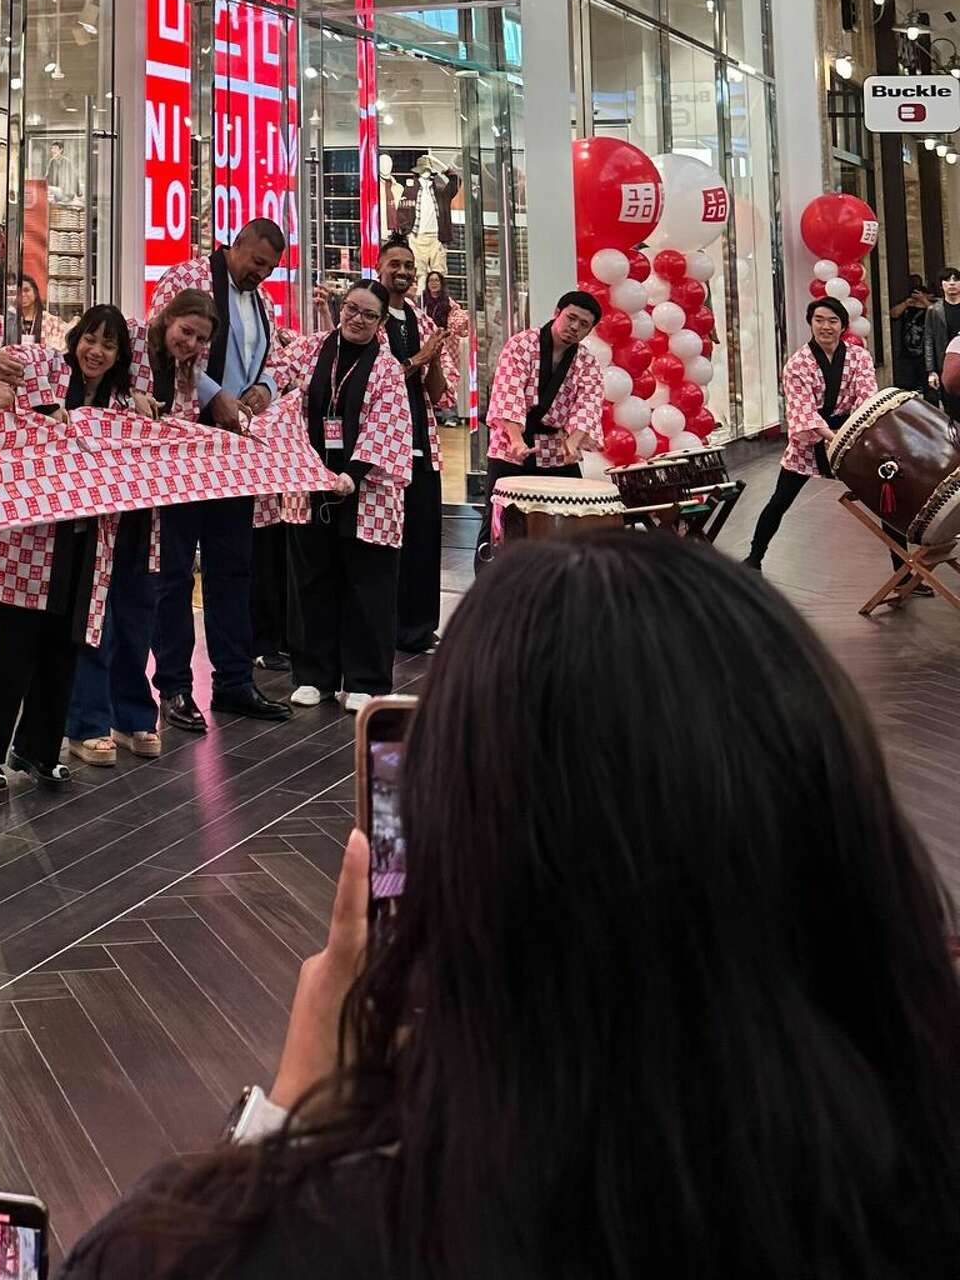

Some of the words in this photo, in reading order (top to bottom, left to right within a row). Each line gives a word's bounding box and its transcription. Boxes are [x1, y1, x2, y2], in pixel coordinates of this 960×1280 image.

[871, 84, 952, 98] Buckle
[145, 100, 180, 163] NI
[145, 177, 186, 240] LO
